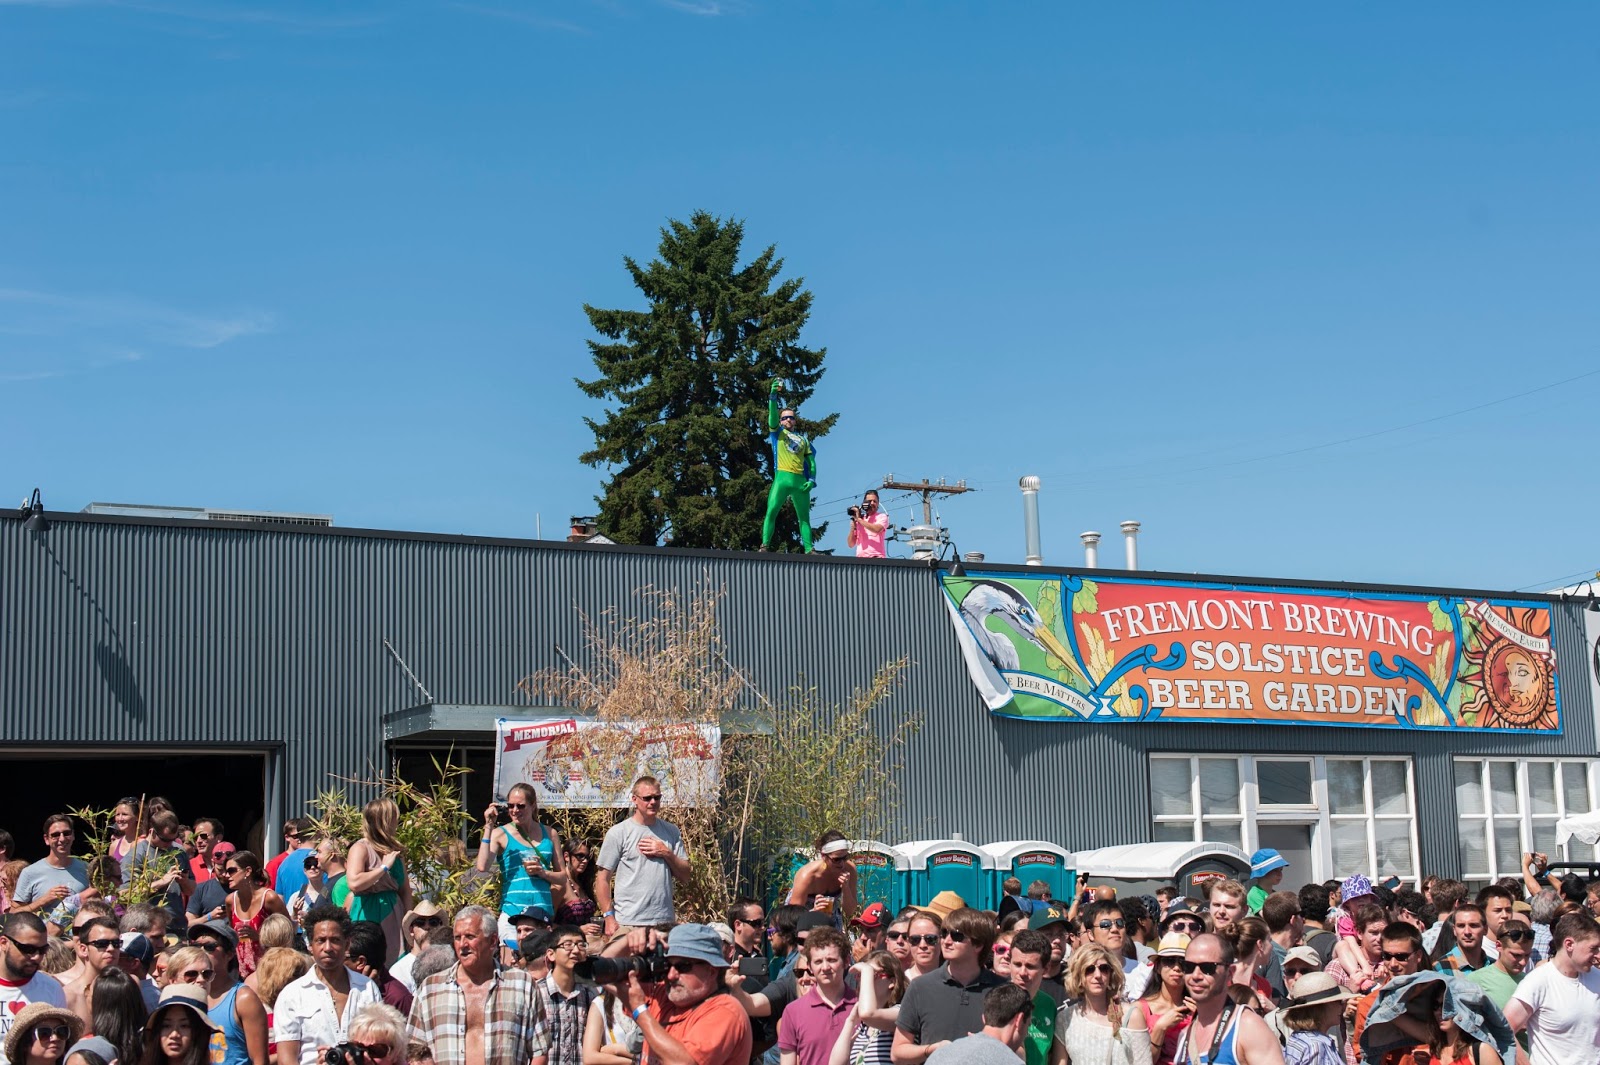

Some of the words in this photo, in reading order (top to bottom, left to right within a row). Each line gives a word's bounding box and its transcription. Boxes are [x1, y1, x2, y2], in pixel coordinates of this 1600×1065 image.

[1101, 599, 1275, 642] FREMONT
[1280, 602, 1435, 656] BREWING
[1519, 633, 1545, 650] EARTH
[1191, 640, 1366, 677] SOLSTICE
[1148, 678, 1253, 710] BEER
[1262, 681, 1407, 716] GARDEN
[513, 723, 575, 742] MEMORIAL
